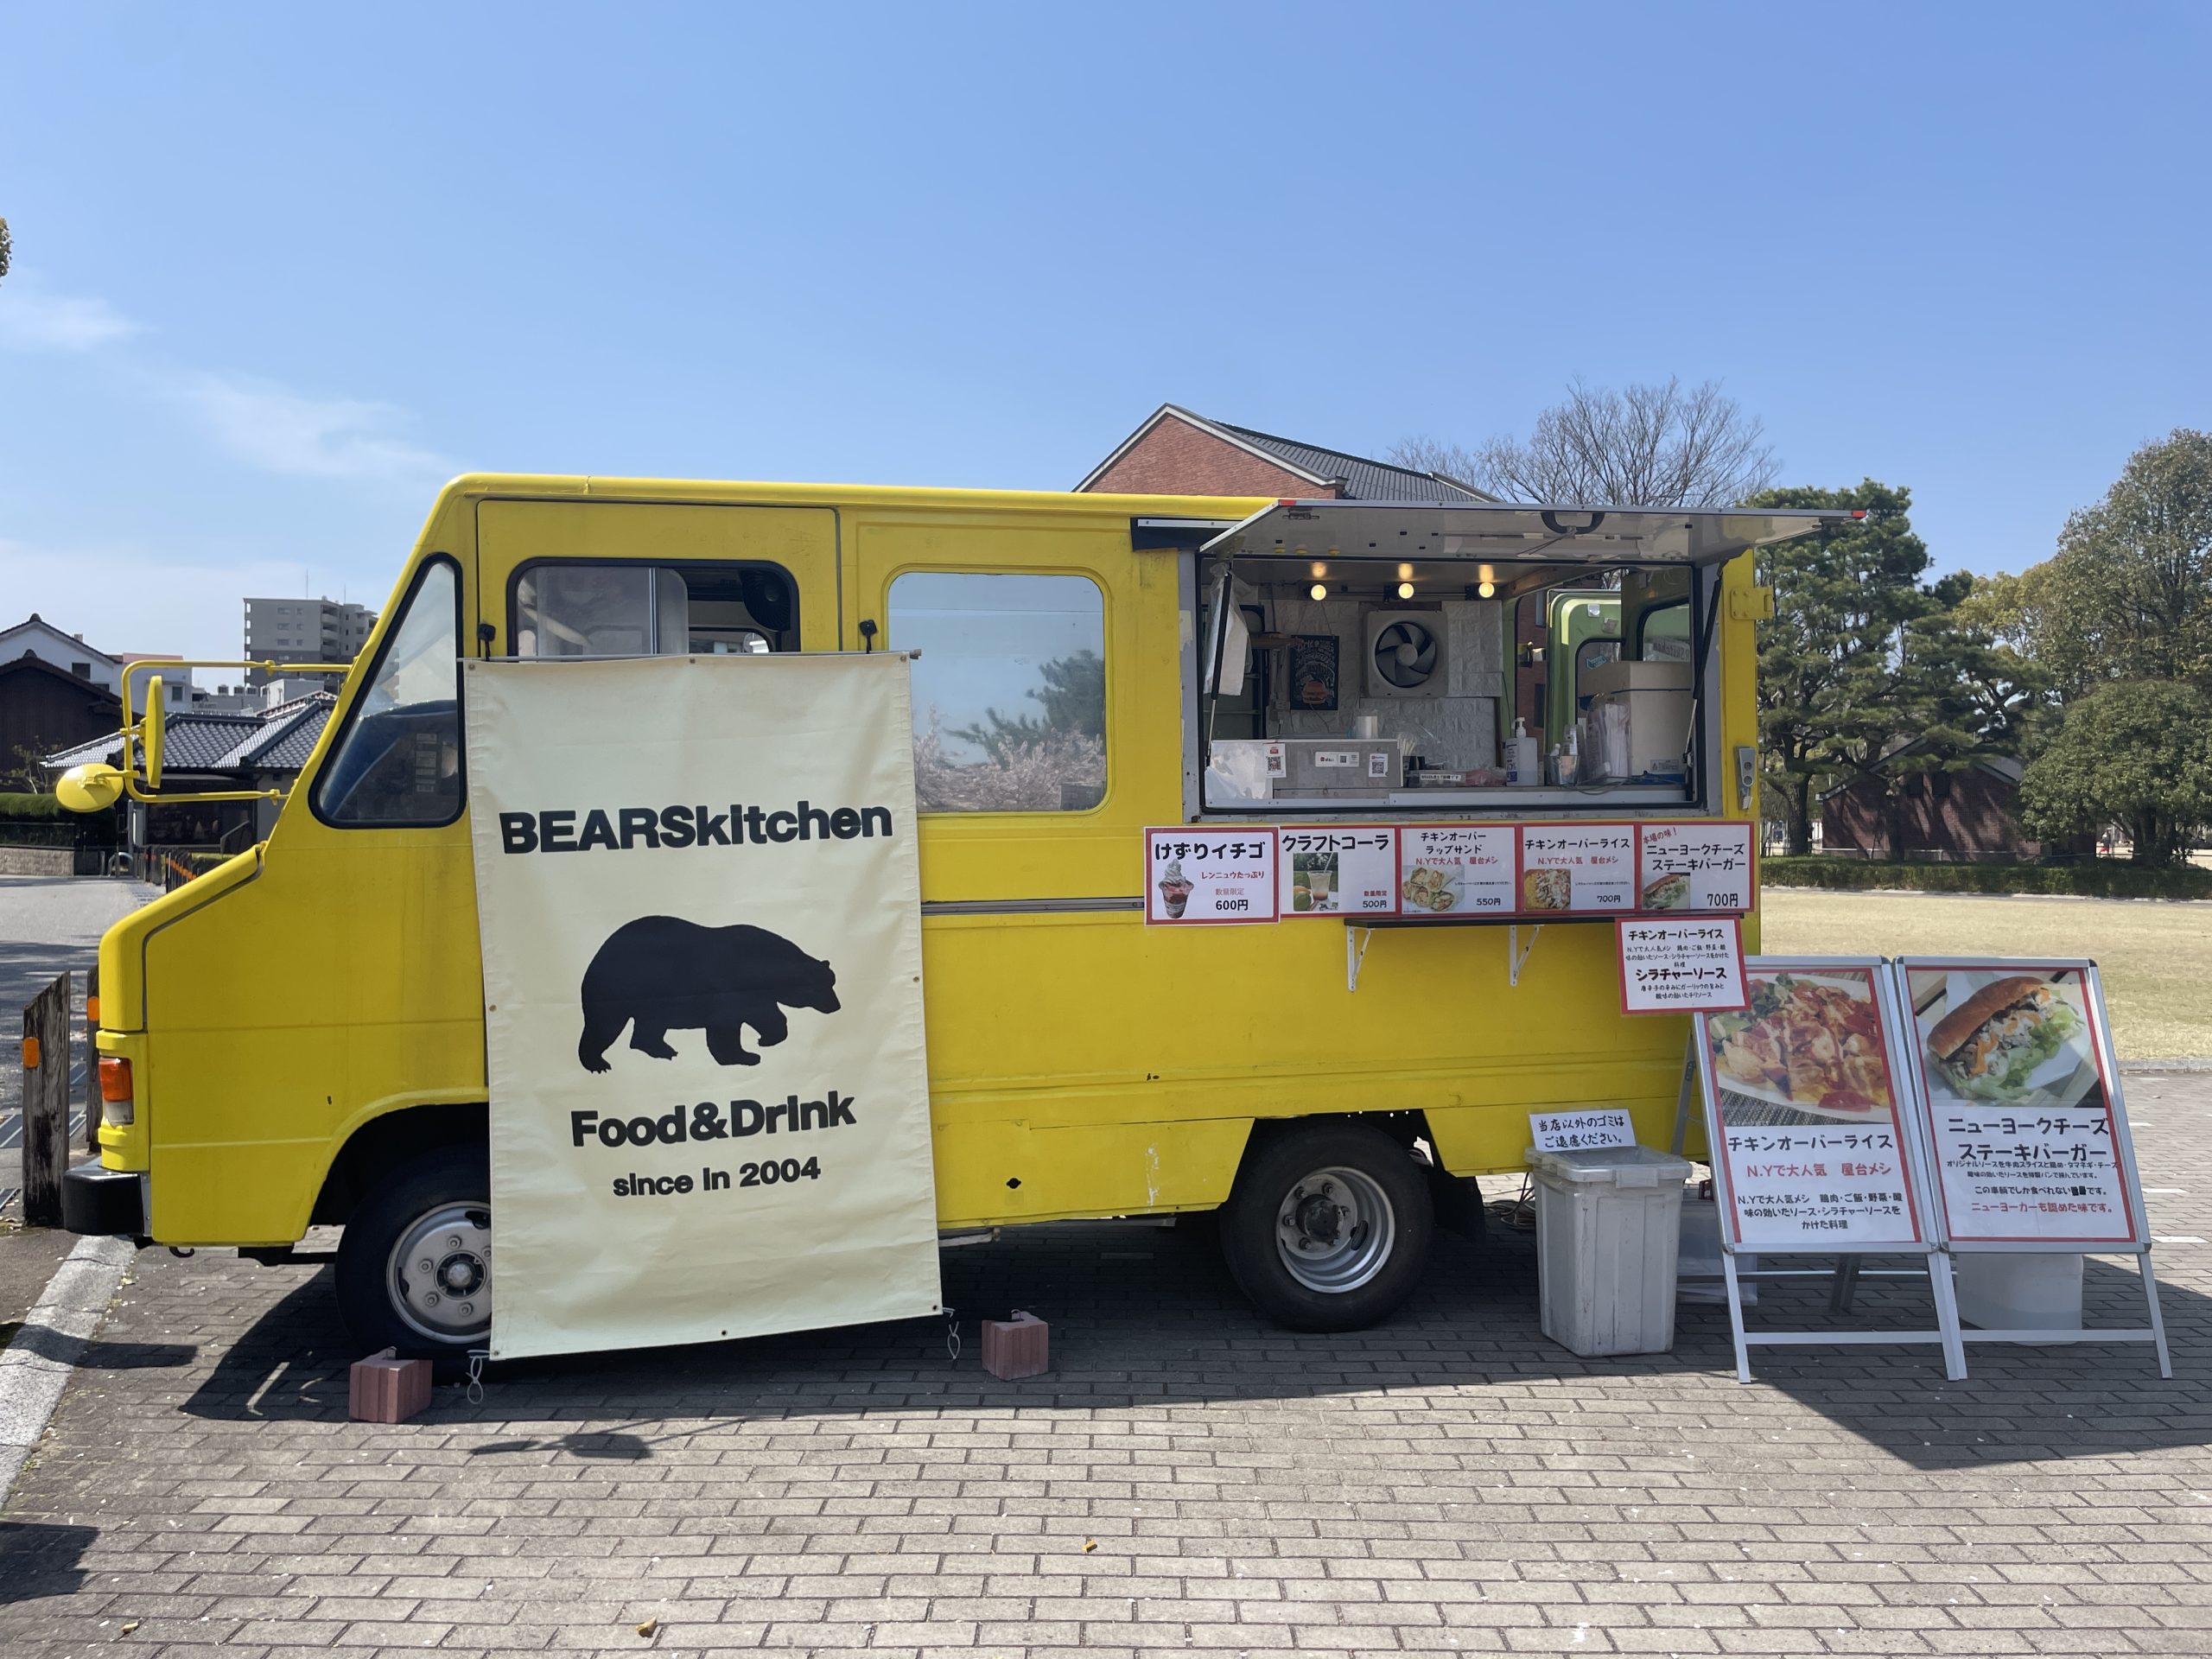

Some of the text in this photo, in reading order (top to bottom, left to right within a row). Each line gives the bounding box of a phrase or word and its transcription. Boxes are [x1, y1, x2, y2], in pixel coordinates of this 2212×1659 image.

[499, 800, 893, 854] BEARSkitchen
[1282, 834, 1389, 852] クラフトコーラ
[1421, 831, 1486, 842] チキンオーバー
[1425, 844, 1483, 855] ラップサンド
[1525, 837, 1630, 850] チキンオーバーライス
[1647, 843, 1745, 855] ニューヨークチーズ
[1154, 842, 1266, 861] けずりイチゴ
[1652, 858, 1746, 871] ステーキバーガー
[1200, 870, 1265, 880] レンニュウたっぷり
[1215, 887, 1244, 897] 数量限定
[1215, 899, 1249, 912] 600円
[1363, 899, 1387, 908] 500円
[1476, 898, 1501, 906] 550円
[1707, 893, 1738, 907] 700円
[1628, 928, 1725, 941] チキンオーバーライス
[1636, 967, 1727, 982] シラチャーソース
[571, 1091, 856, 1148] Food&Drink
[1538, 1115, 1624, 1133] 当店以外のゴミは
[1948, 1117, 2109, 1135] ニューヨークチーズ
[1544, 1132, 1623, 1148] ご遠慮ください。
[1728, 1134, 1893, 1152] チキンオーバーライス
[1958, 1142, 2107, 1161] ステーキバーガー
[1747, 1162, 1891, 1178] N.Yで大人気 屋台メシ
[613, 1157, 821, 1197] since in 2004
[1738, 1194, 1810, 1205] N.Yで大人気メシ
[1971, 1202, 2113, 1212] ニューヨーカーも認めた味です。
[1802, 1219, 1848, 1230] かけた料理
